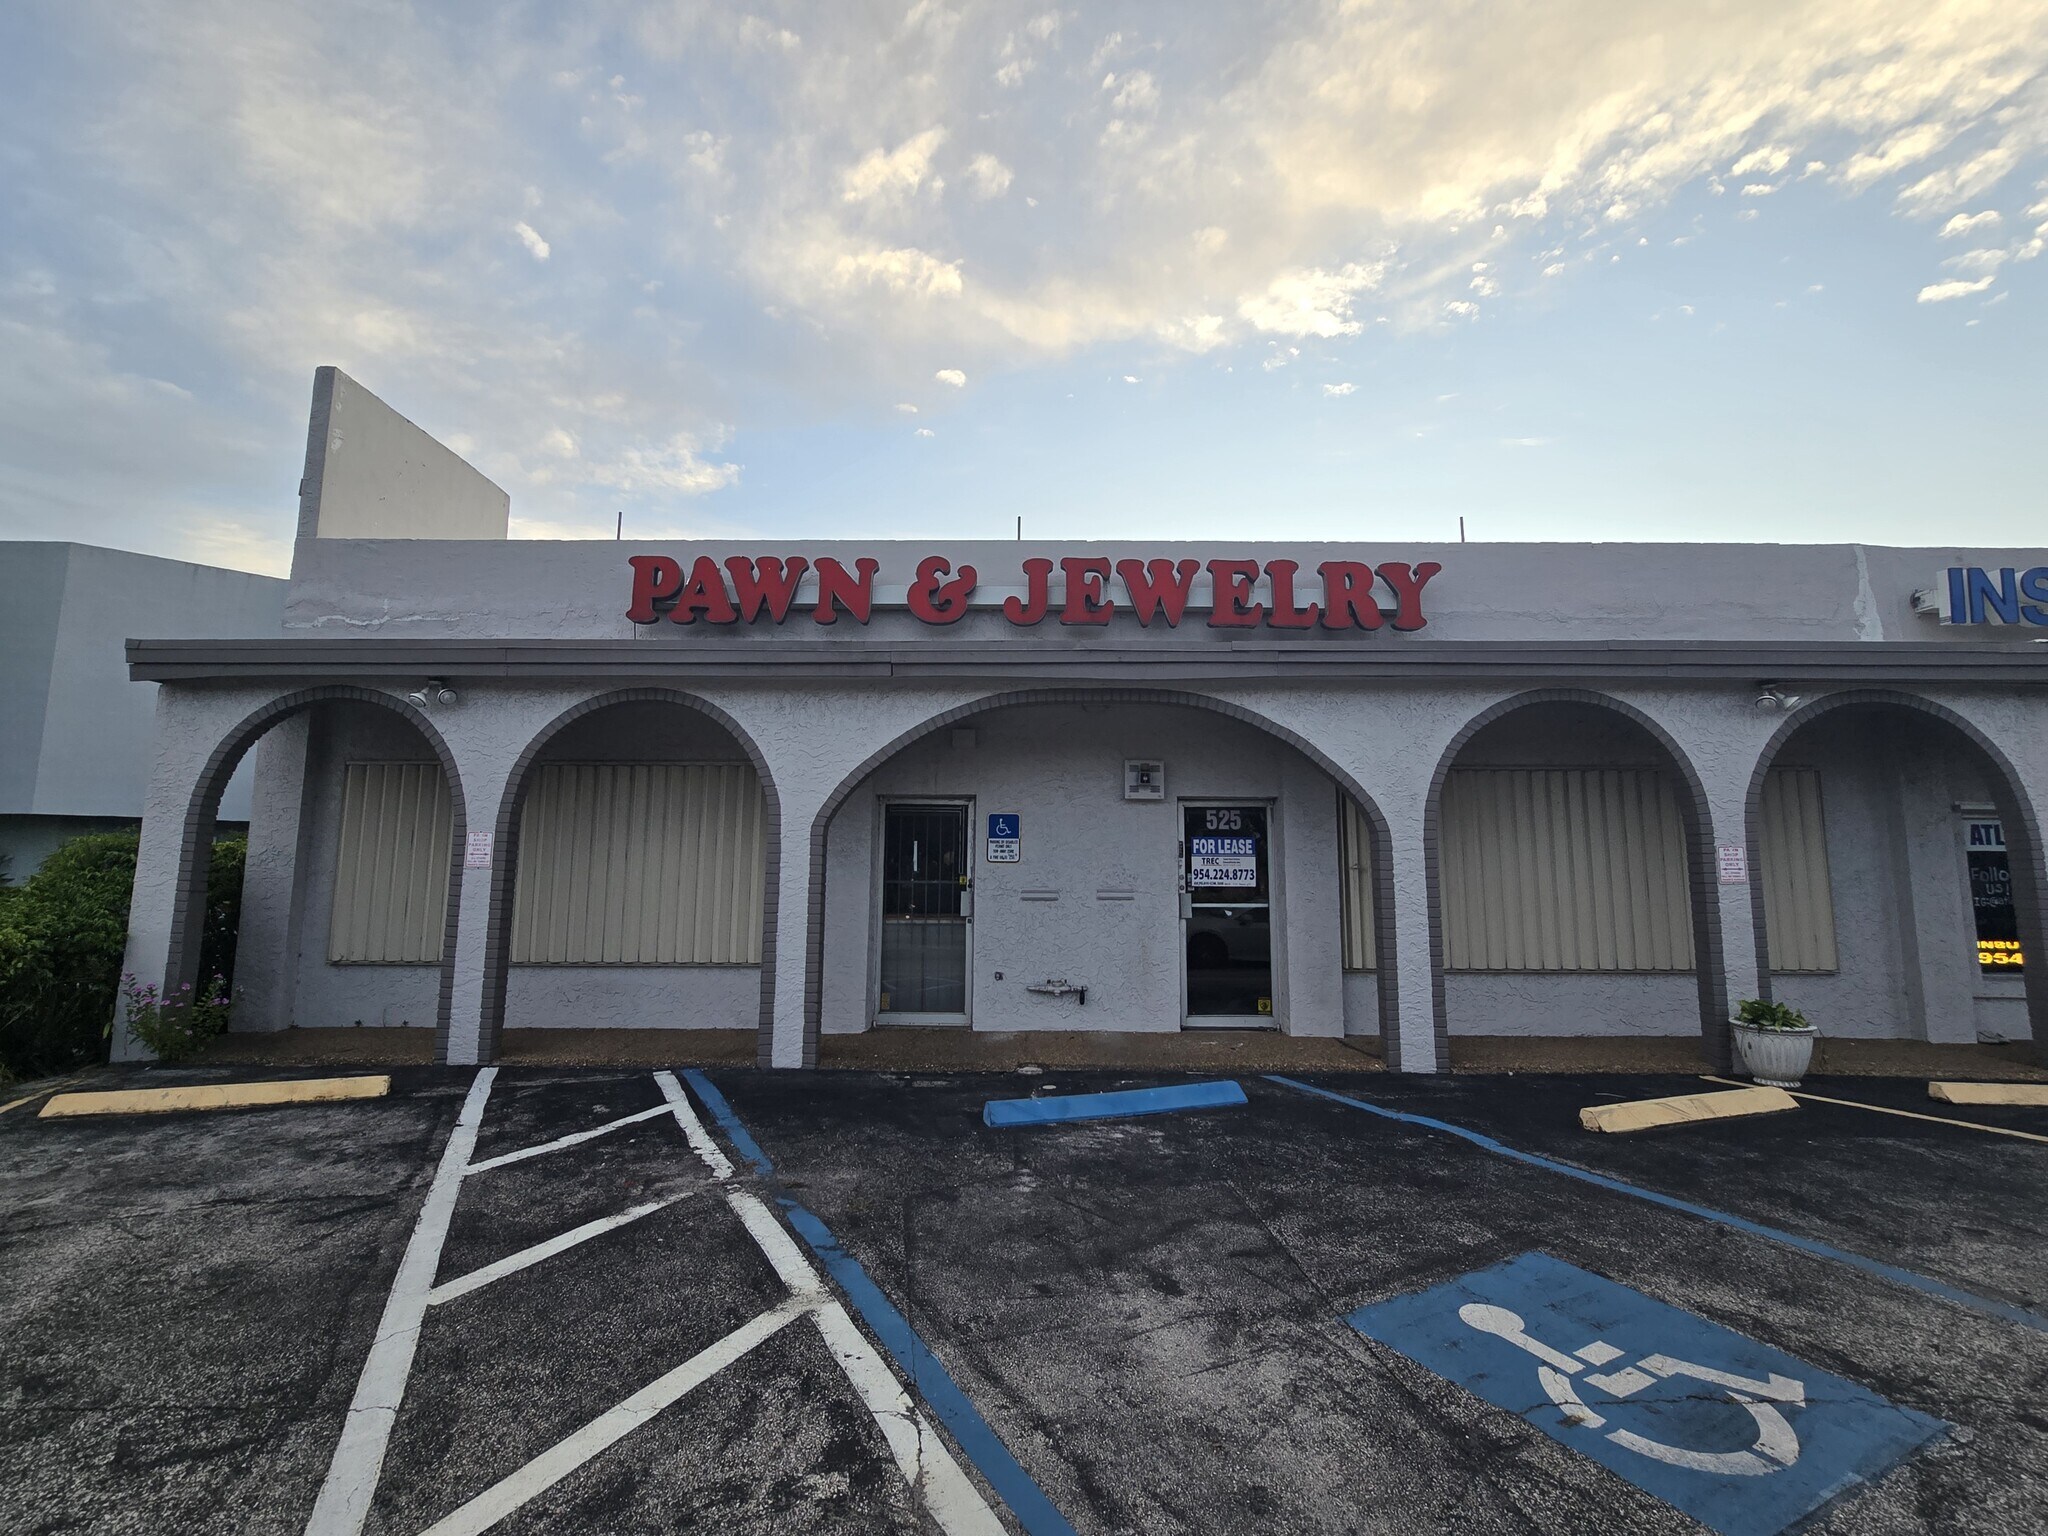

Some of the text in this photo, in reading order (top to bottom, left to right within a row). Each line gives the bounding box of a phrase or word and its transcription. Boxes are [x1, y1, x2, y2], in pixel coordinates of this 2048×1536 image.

[626, 555, 1442, 631] PAWN & JEWELRY
[1947, 567, 2048, 626] INS
[1206, 809, 1242, 830] 525
[1970, 824, 2006, 846] ATL
[1193, 839, 1253, 854] FOR LEASE
[1193, 868, 1255, 880] 954.224.8773
[1978, 952, 2023, 965] 954
